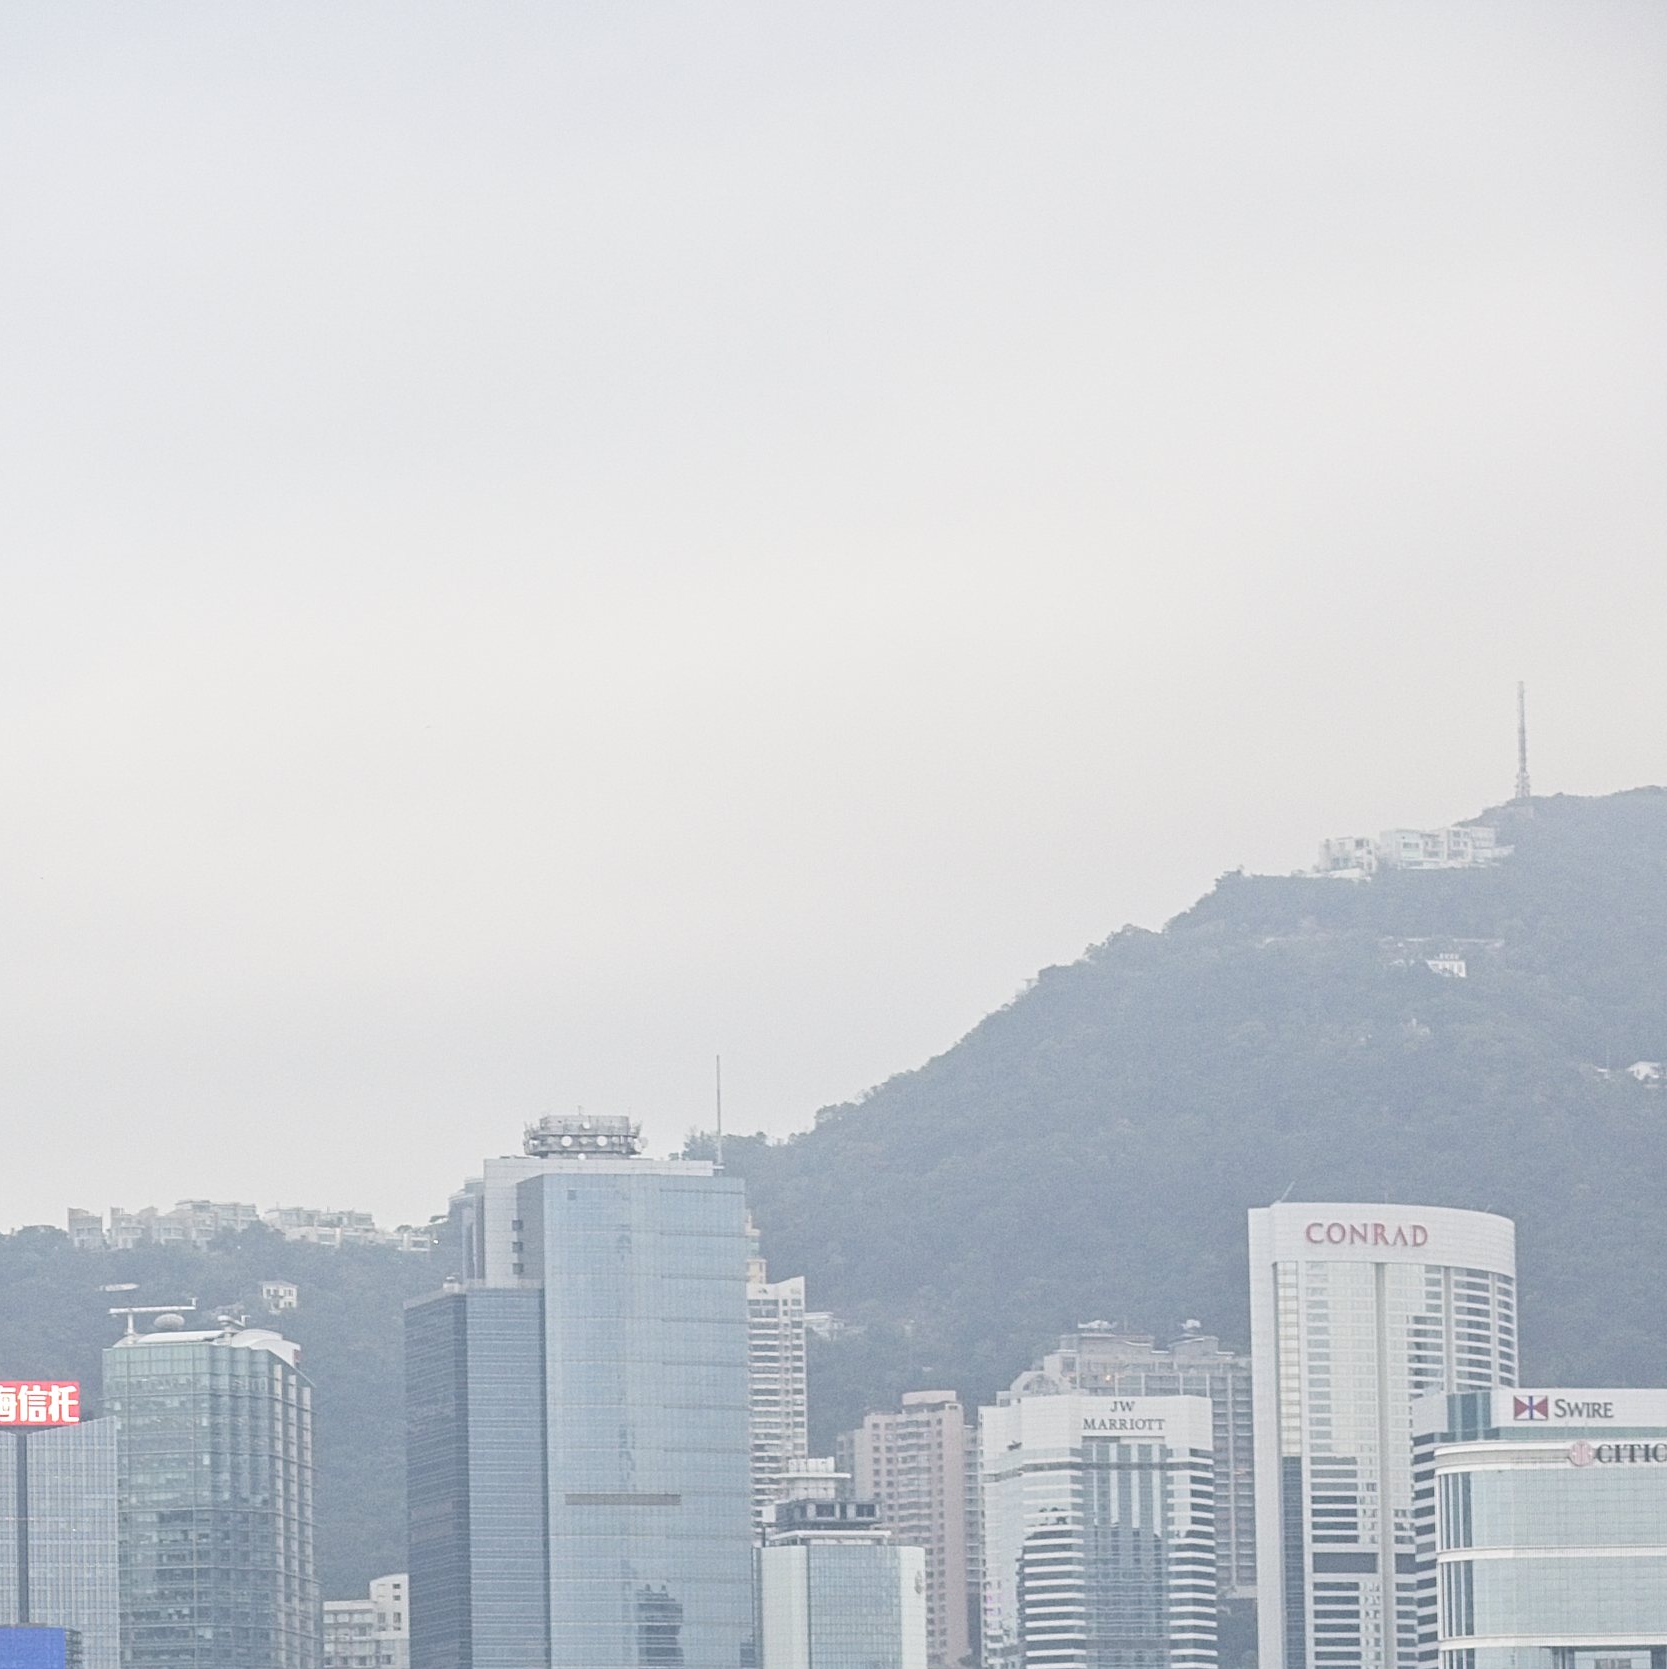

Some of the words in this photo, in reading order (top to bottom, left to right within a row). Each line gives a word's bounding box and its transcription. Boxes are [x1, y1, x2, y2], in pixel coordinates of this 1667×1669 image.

[1305, 1222, 1428, 1247] CONRAD
[1110, 1400, 1135, 1413] JW
[1082, 1418, 1166, 1431] MARRIOTT
[1595, 1443, 1667, 1464] CITIC
